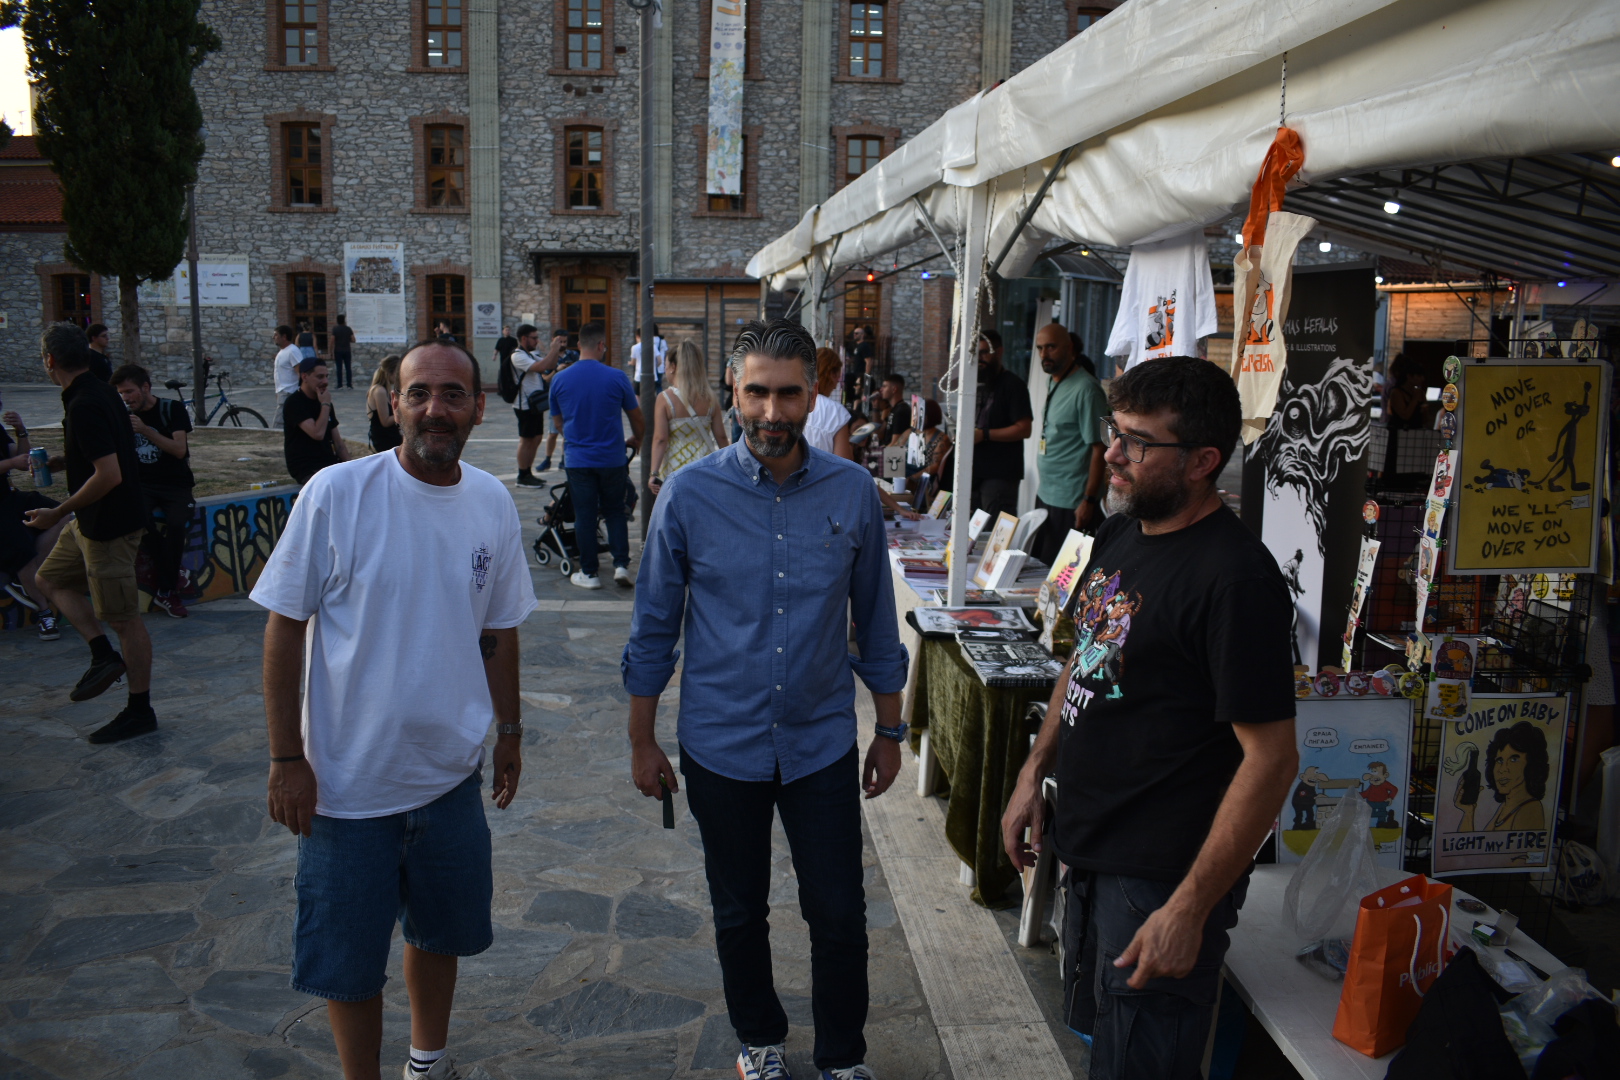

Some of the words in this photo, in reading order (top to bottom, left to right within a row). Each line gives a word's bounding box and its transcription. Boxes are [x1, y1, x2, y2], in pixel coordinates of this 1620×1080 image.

[1296, 344, 1337, 352] ILLUSTRATIONS
[1490, 378, 1536, 410] MOVE
[1486, 413, 1508, 436] ON
[1514, 392, 1552, 418] OVER
[1516, 420, 1536, 440] OR
[1492, 505, 1520, 517] WE
[1487, 519, 1534, 535] MOVE
[1542, 518, 1563, 531] ON
[1481, 539, 1526, 560] OVER
[1533, 531, 1571, 550] YOU
[1454, 708, 1496, 736] COME
[1498, 704, 1517, 722] ON
[1520, 701, 1560, 725] BABY
